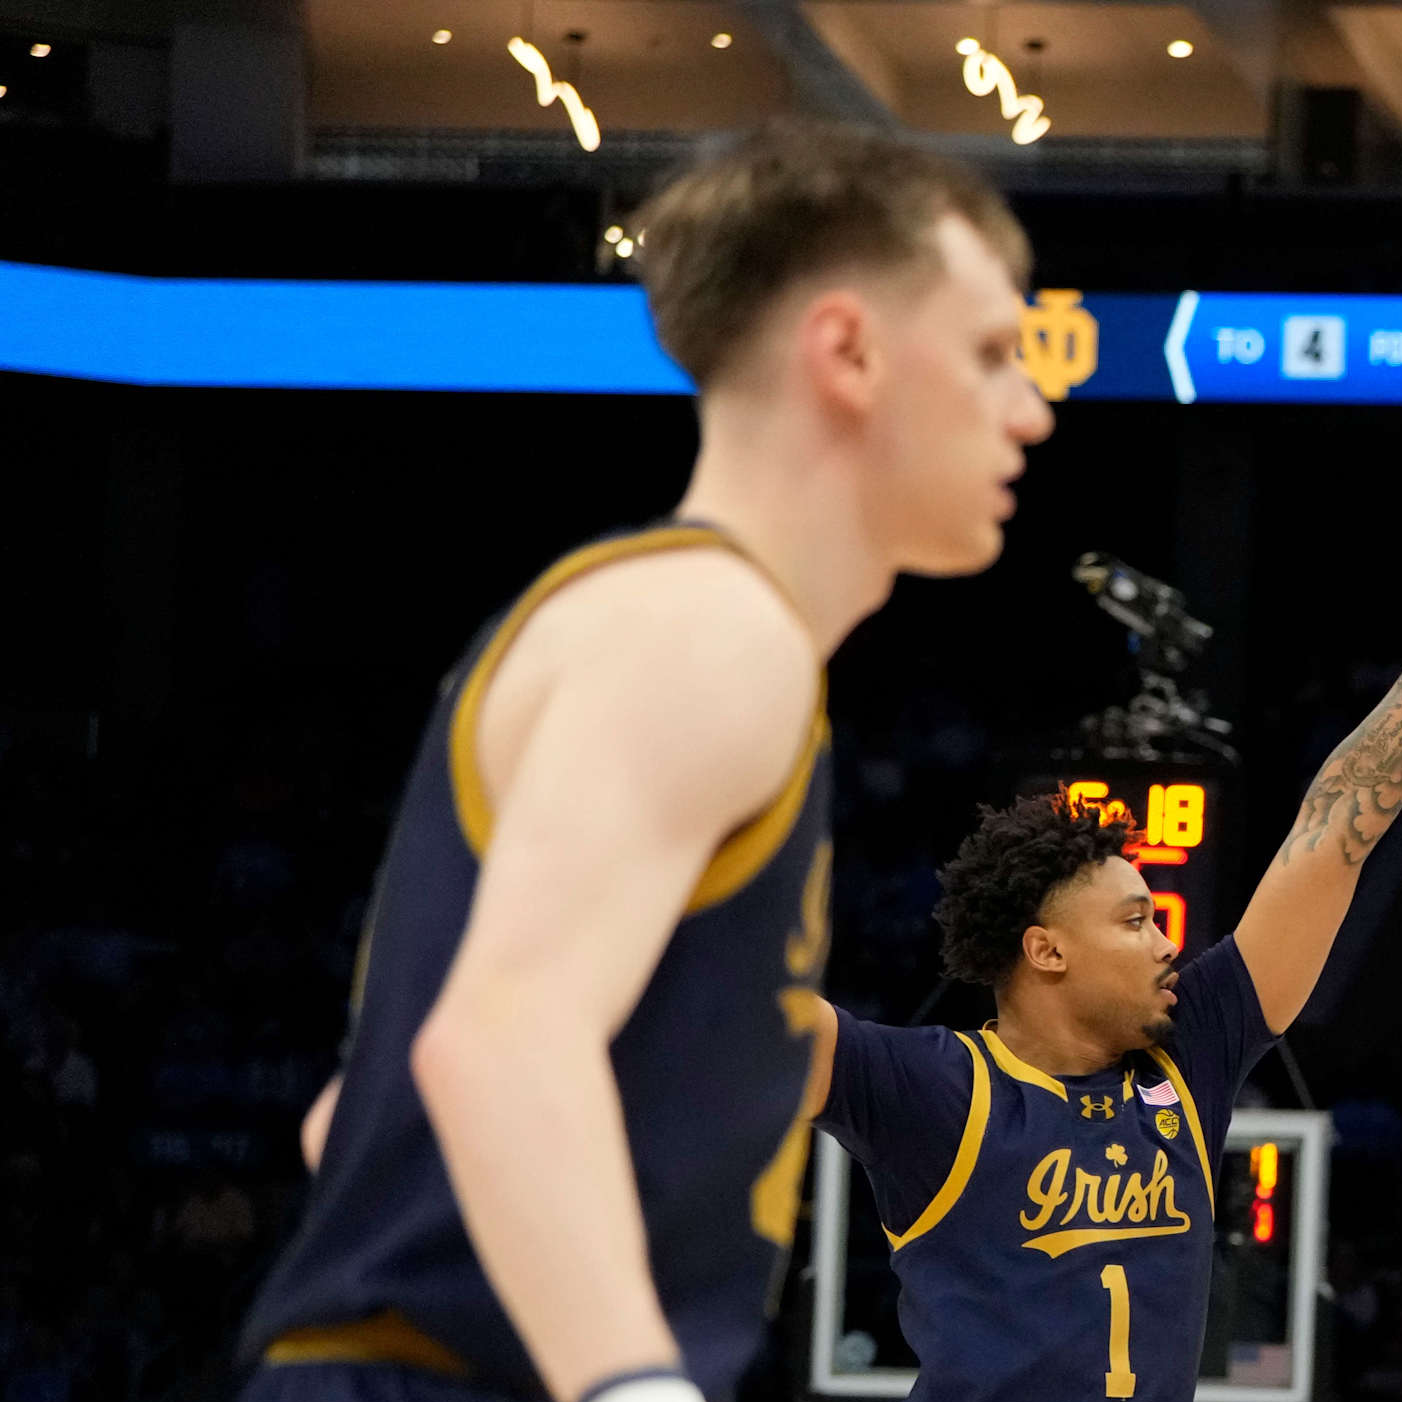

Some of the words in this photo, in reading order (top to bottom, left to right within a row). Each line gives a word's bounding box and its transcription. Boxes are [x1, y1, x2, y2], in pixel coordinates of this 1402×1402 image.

[1214, 327, 1265, 365] TO
[1019, 1147, 1191, 1258] Irish
[1100, 1264, 1136, 1399] 1
